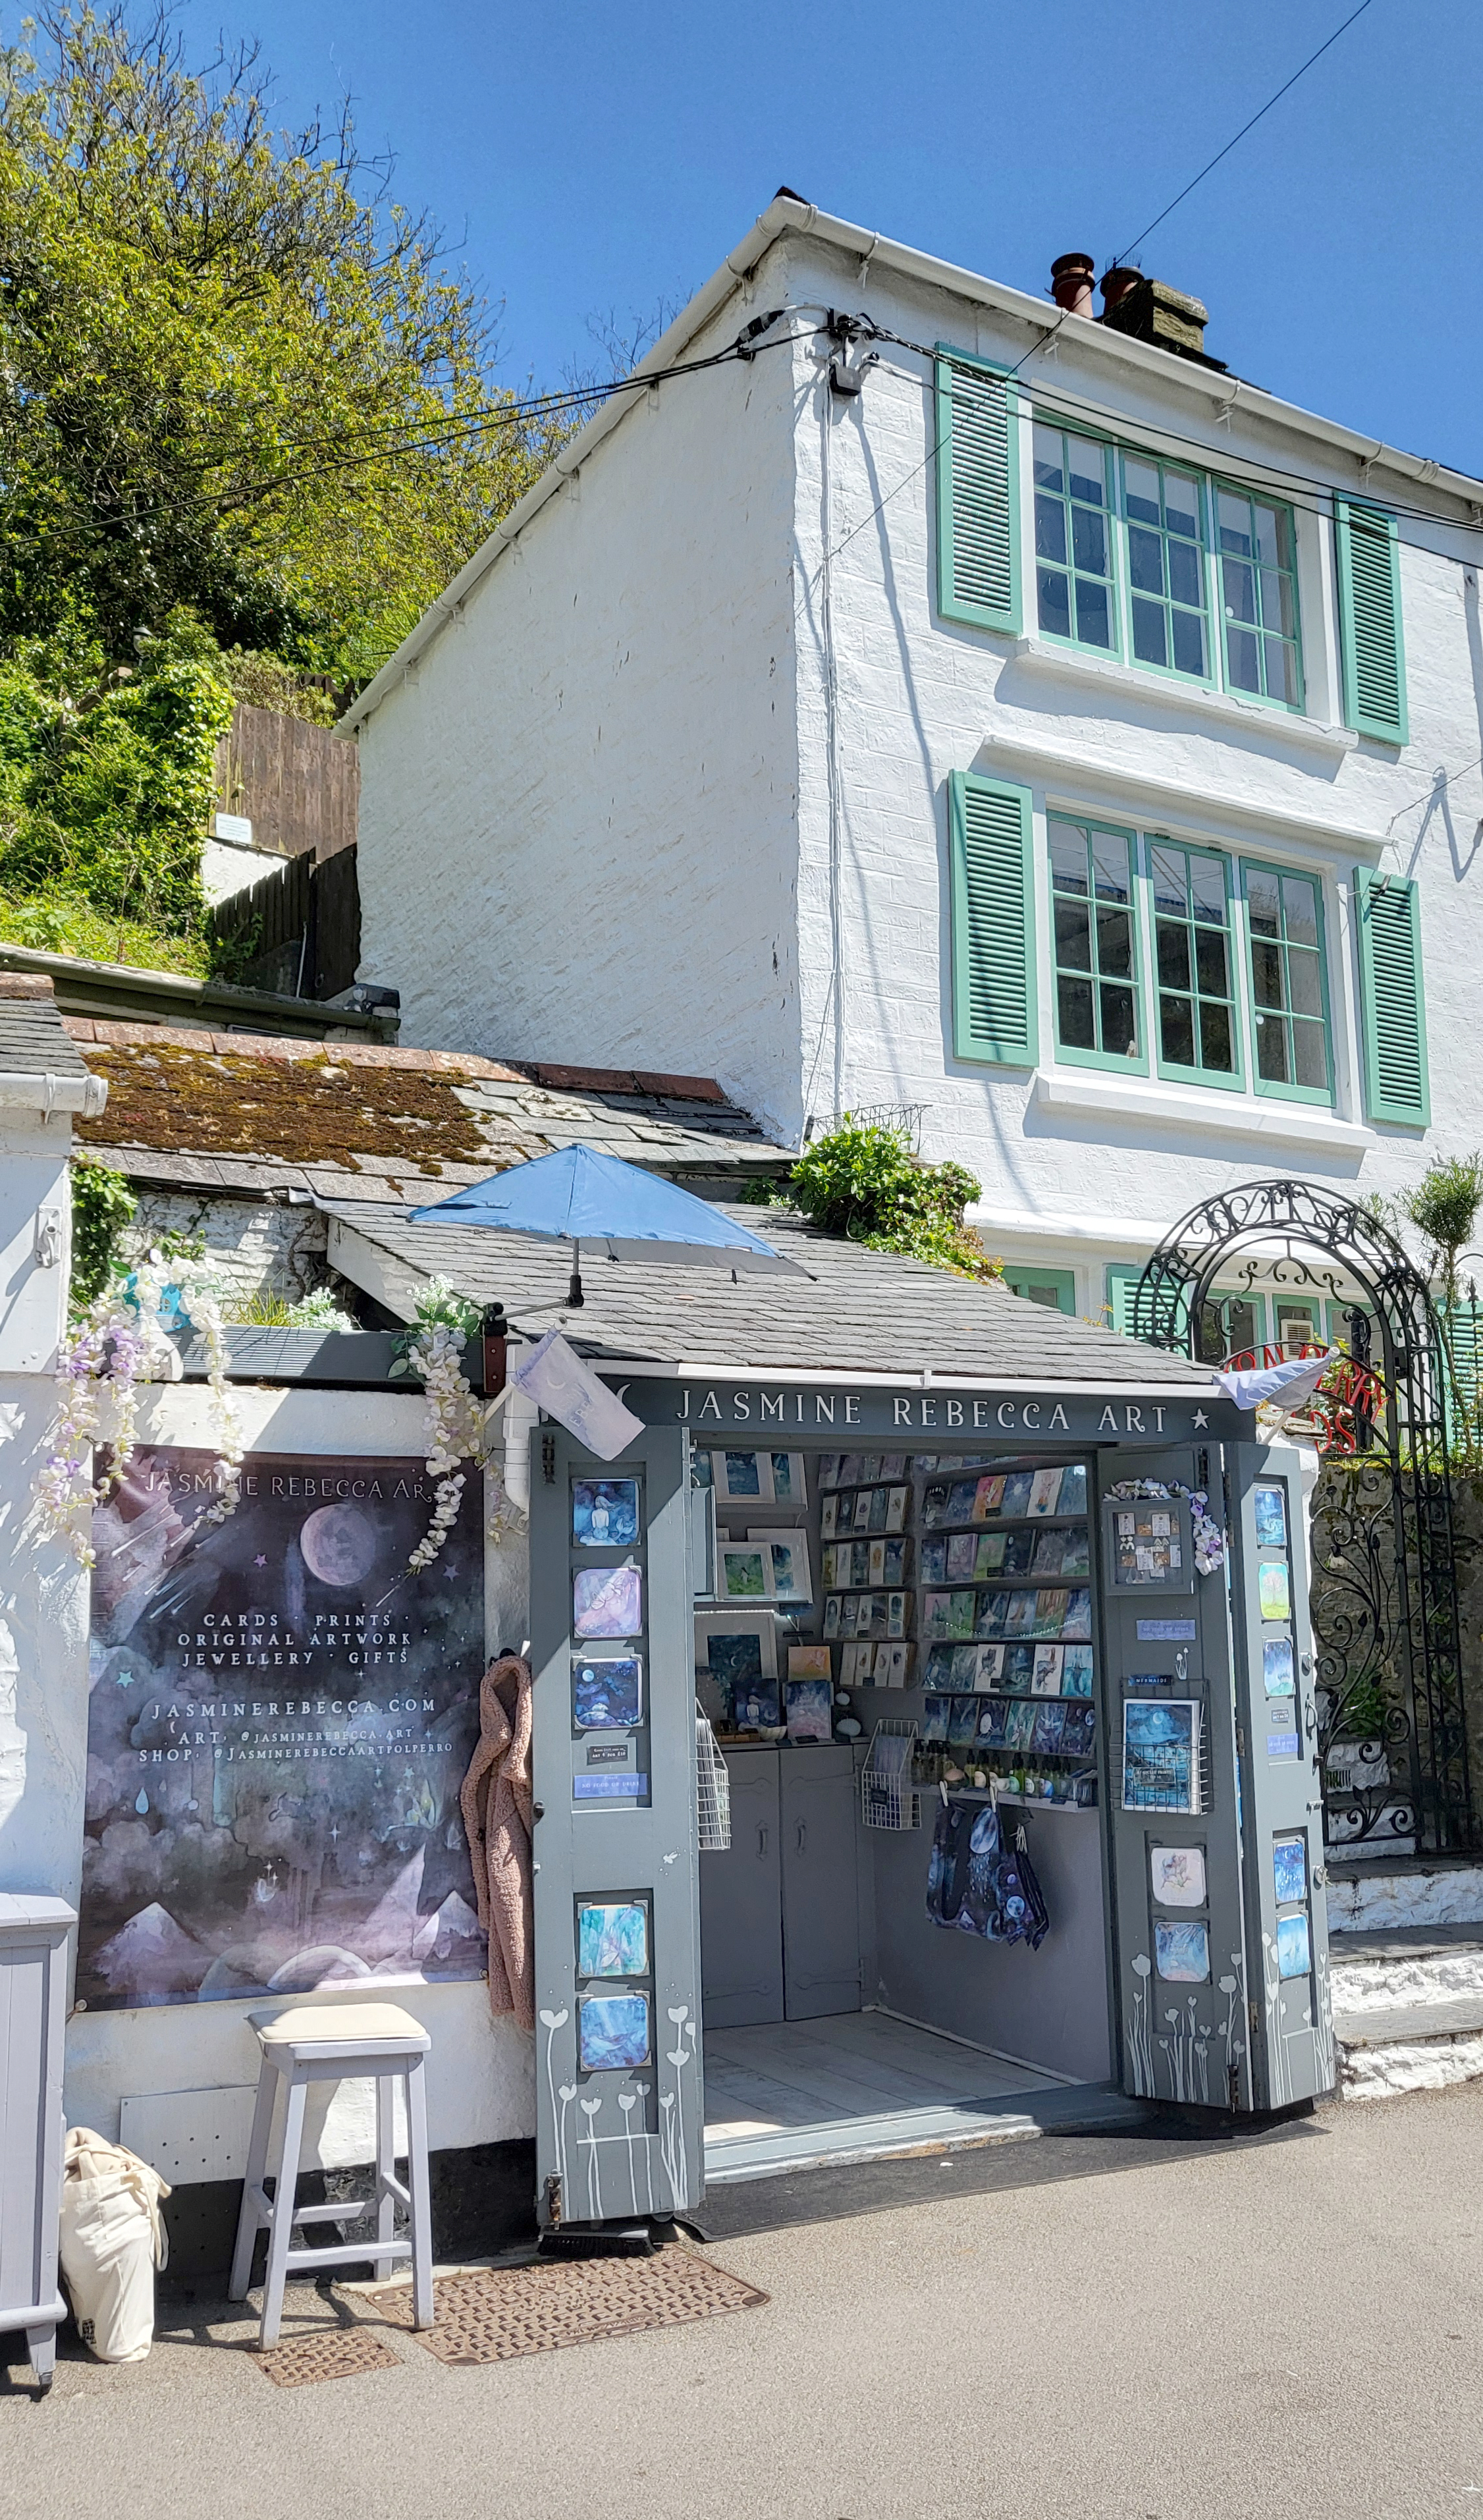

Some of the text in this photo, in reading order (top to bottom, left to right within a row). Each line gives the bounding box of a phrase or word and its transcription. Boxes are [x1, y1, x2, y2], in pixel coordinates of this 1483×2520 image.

[676, 1390, 1166, 1433] JASMINE REBECCA ART
[271, 1476, 383, 1498] REBECCA
[393, 1479, 433, 1504] AR
[203, 1614, 391, 1627] CARDS PRINTS
[177, 1633, 411, 1646] ORIGINAL ARTWORK
[182, 1651, 408, 1668] JEWELLERY GIFTS
[151, 1699, 435, 1720] JASMINEREBECCA.COM
